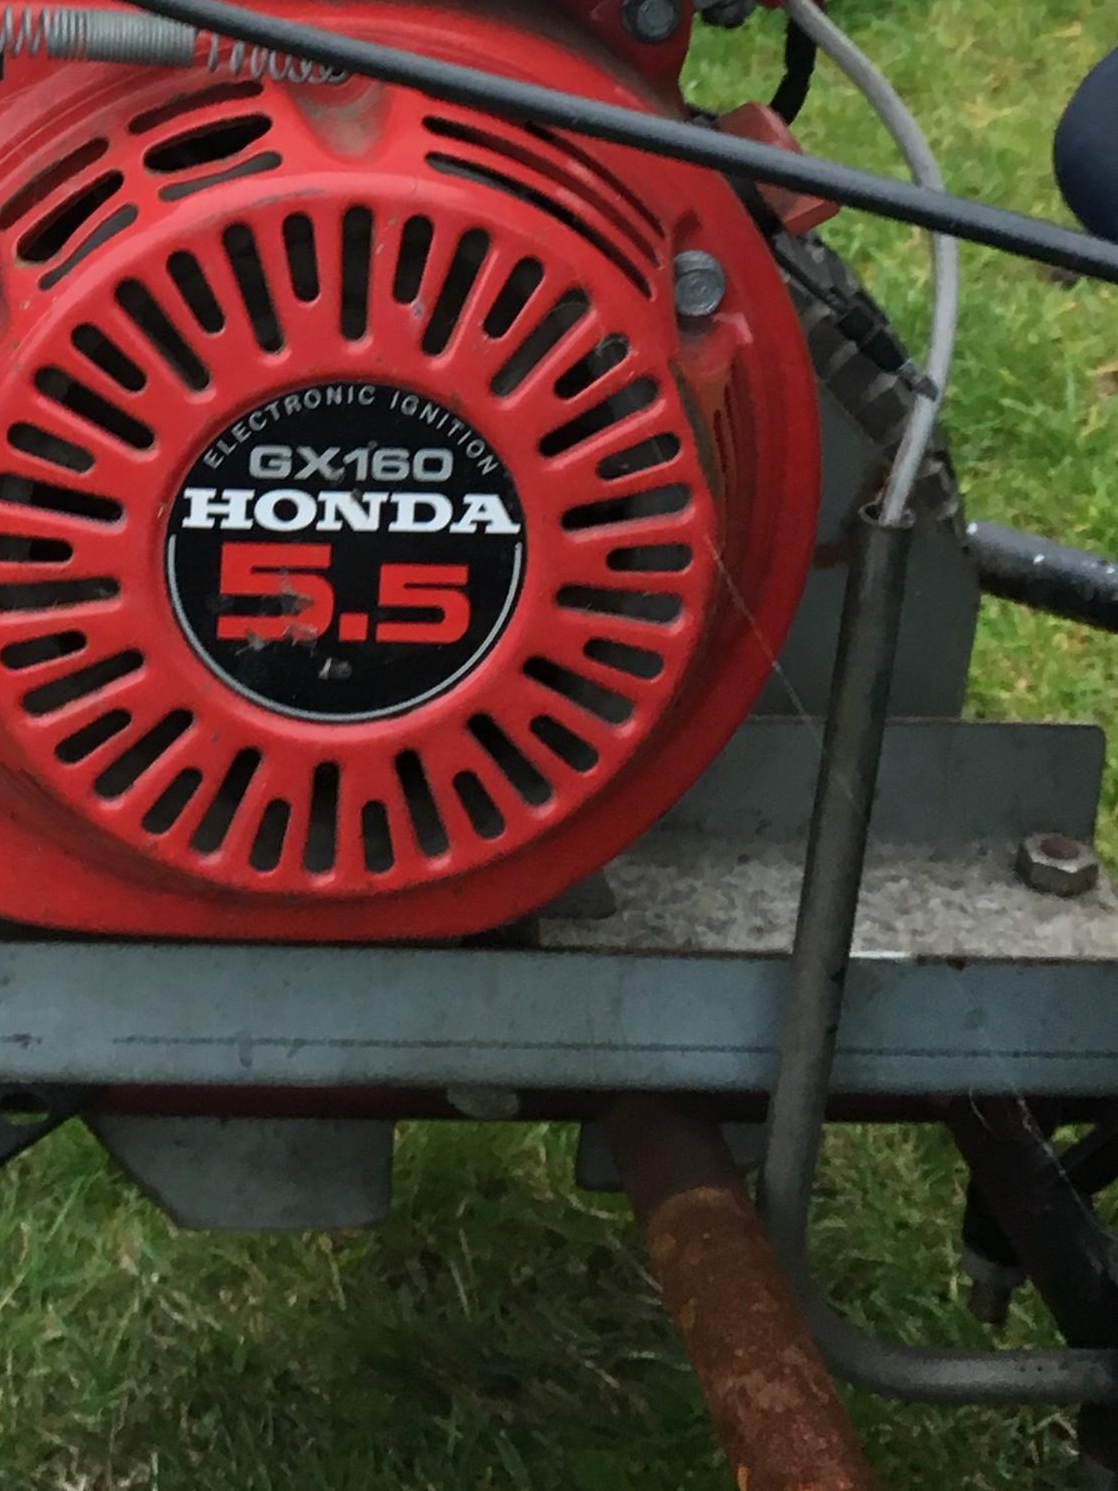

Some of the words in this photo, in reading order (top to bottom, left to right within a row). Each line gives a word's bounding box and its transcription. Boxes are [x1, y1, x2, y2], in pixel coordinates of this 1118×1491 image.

[204, 385, 376, 469] ELECTRONIC
[390, 391, 498, 475] IGNITION
[248, 445, 454, 482] GX160
[182, 487, 521, 534] HONDA
[216, 541, 471, 644] 5.5
